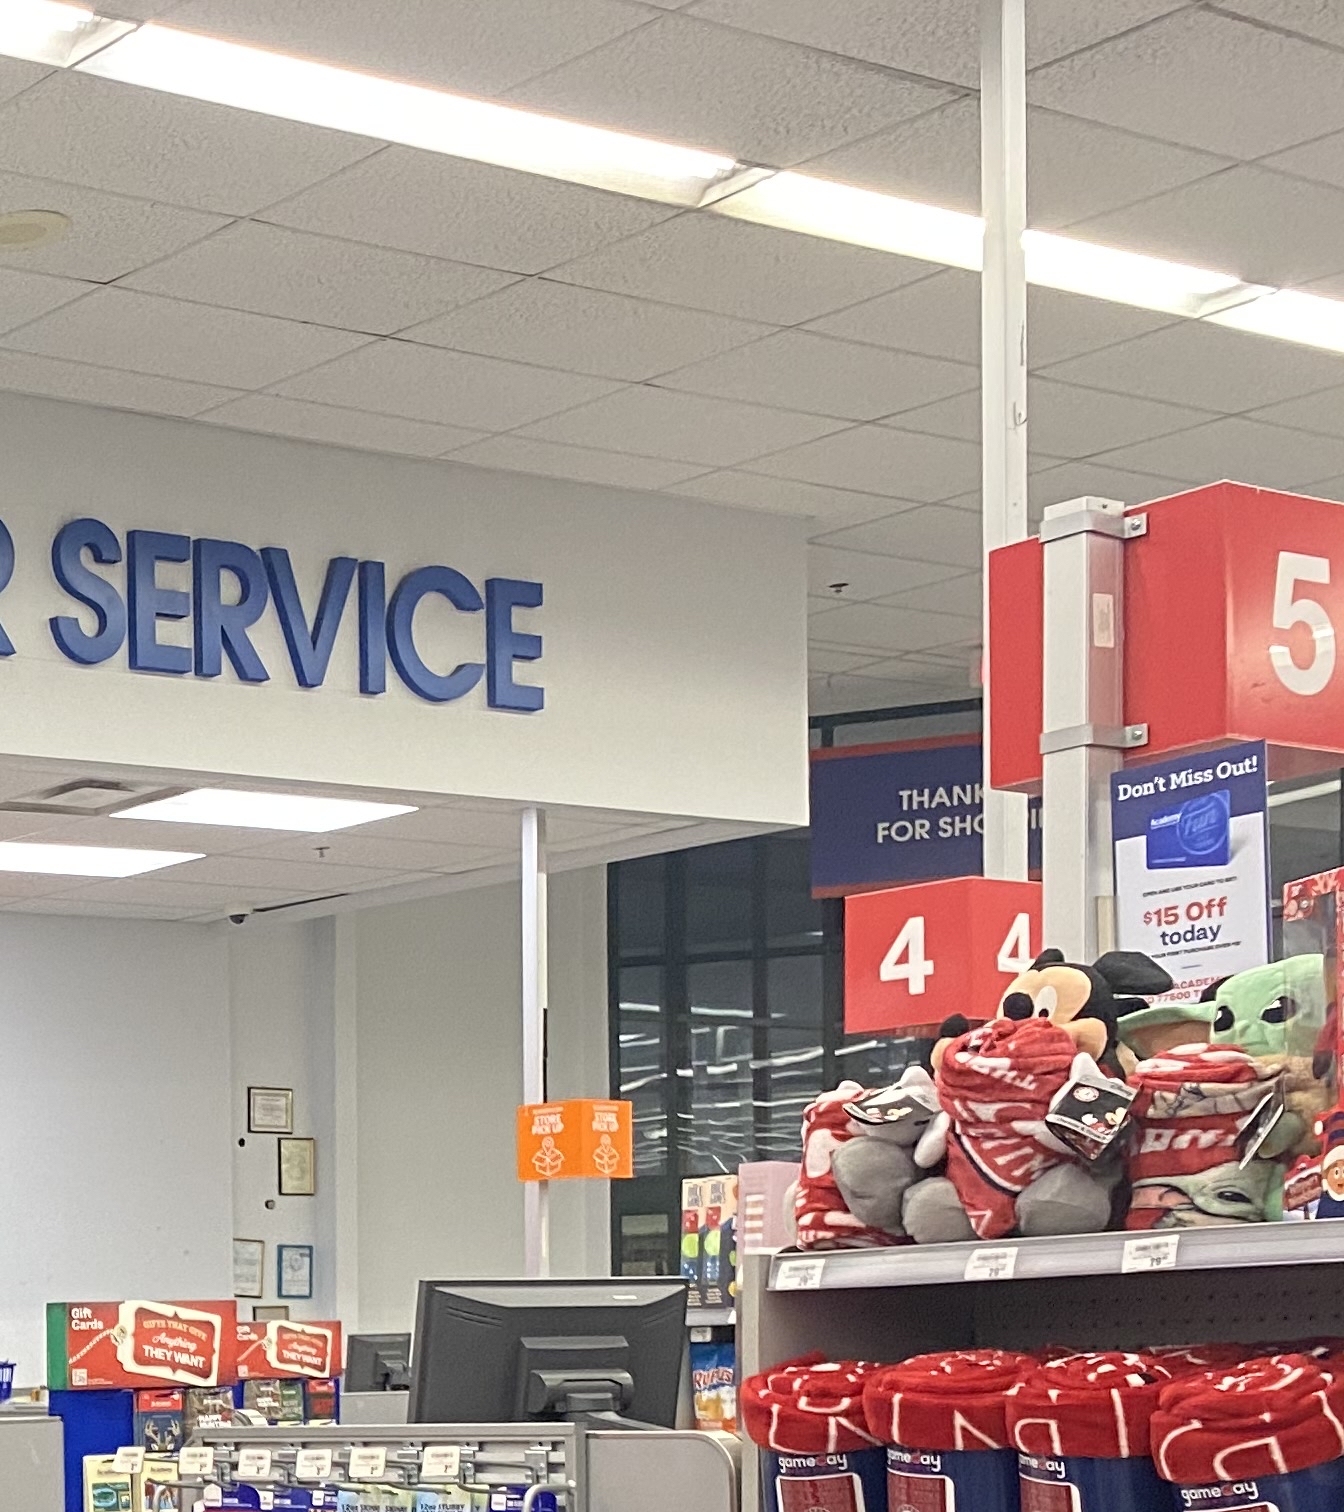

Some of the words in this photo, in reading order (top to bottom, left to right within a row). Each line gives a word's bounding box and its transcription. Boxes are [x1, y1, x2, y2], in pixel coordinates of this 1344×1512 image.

[48, 518, 545, 711] SERVICE
[1268, 550, 1337, 696] 5
[1118, 777, 1166, 801] Don't
[1169, 767, 1213, 791] Miss
[1216, 755, 1259, 777] Out!
[876, 820, 930, 844] FOR
[1143, 905, 1179, 927] $15
[1185, 896, 1228, 921] Off
[1160, 924, 1222, 946] today
[878, 915, 935, 996] 4
[997, 912, 1036, 975] 4
[531, 1123, 551, 1136] PICK
[551, 1122, 564, 1135] UP
[533, 1113, 563, 1127] STORE
[592, 1112, 617, 1125] STORE
[70, 1307, 92, 1320] Gift
[70, 1318, 104, 1331] Cards
[166, 1320, 189, 1333] THAT
[188, 1325, 208, 1341] GIVE
[152, 1333, 198, 1354] Anything
[142, 1345, 172, 1363] THEY
[172, 1352, 206, 1369] WANT
[282, 1349, 302, 1362] THEY
[301, 1354, 323, 1366] WANT
